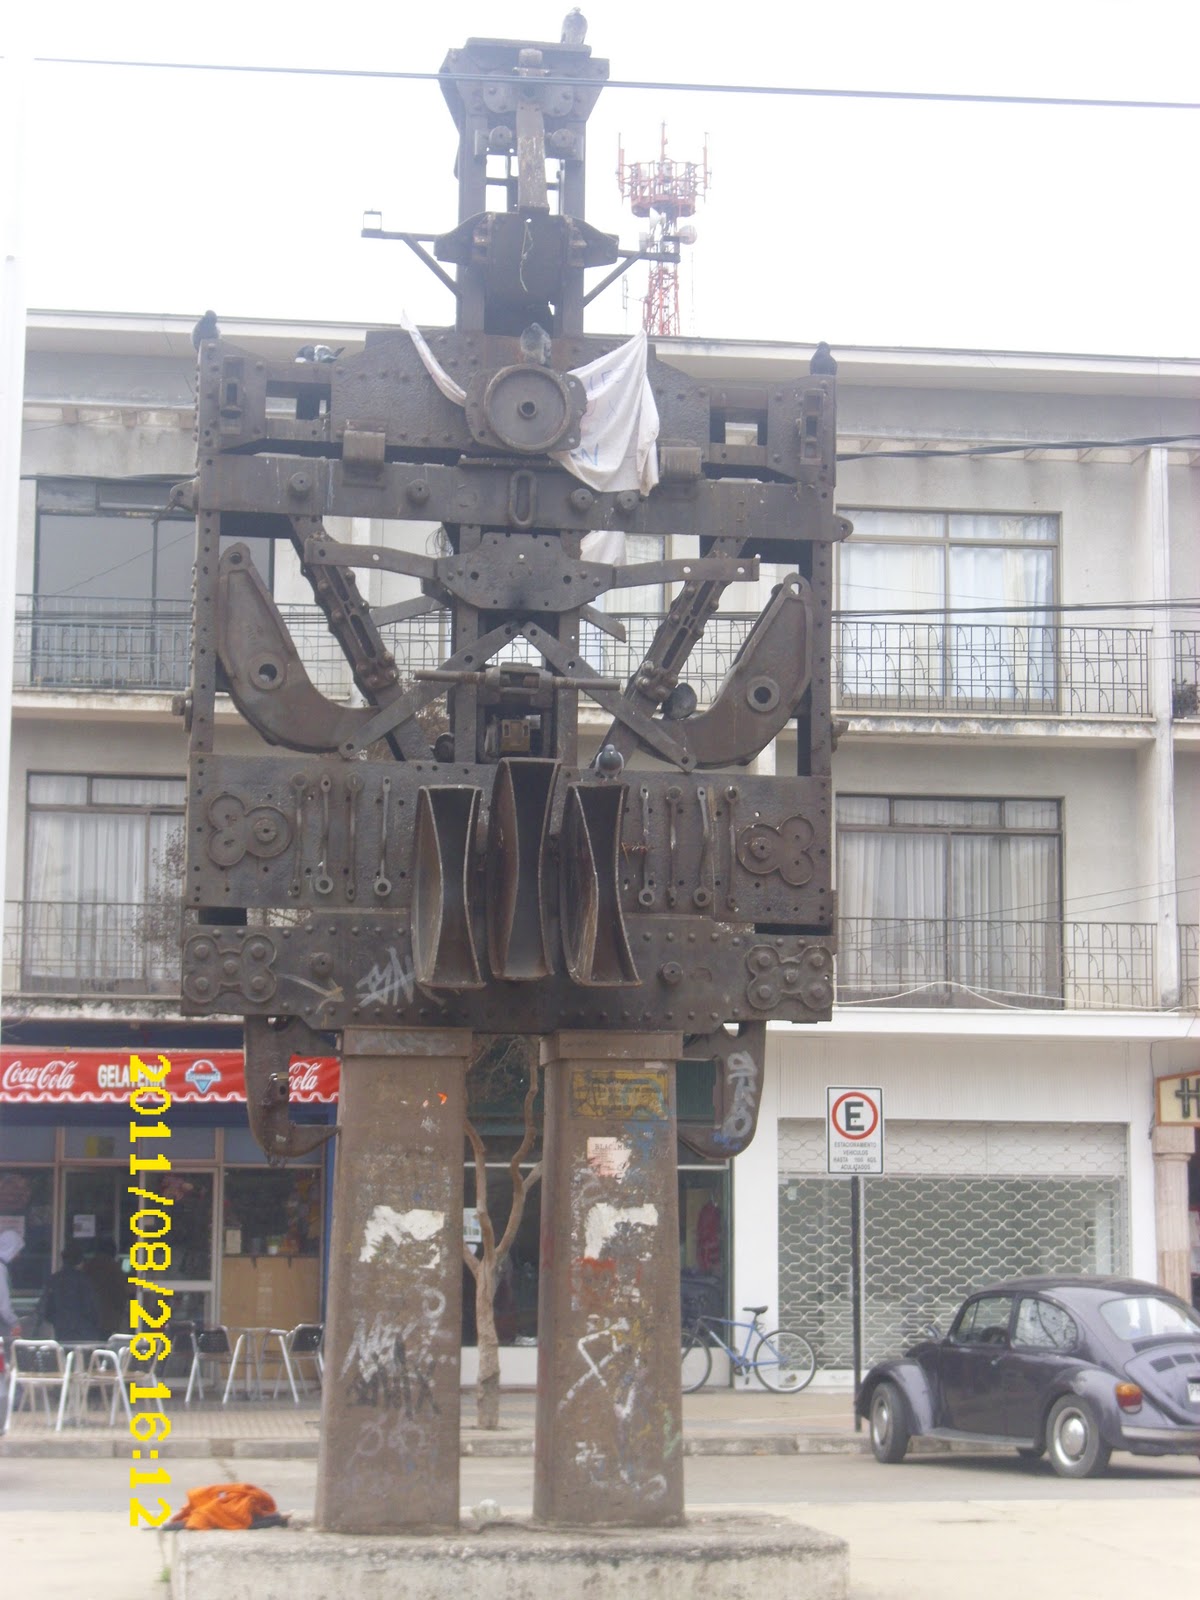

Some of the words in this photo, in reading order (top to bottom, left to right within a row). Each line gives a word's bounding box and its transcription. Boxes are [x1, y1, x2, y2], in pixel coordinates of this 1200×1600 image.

[2, 1060, 78, 1090] Coca-Cola
[97, 1064, 166, 1088] GELAERIA
[845, 1101, 865, 1131] E
